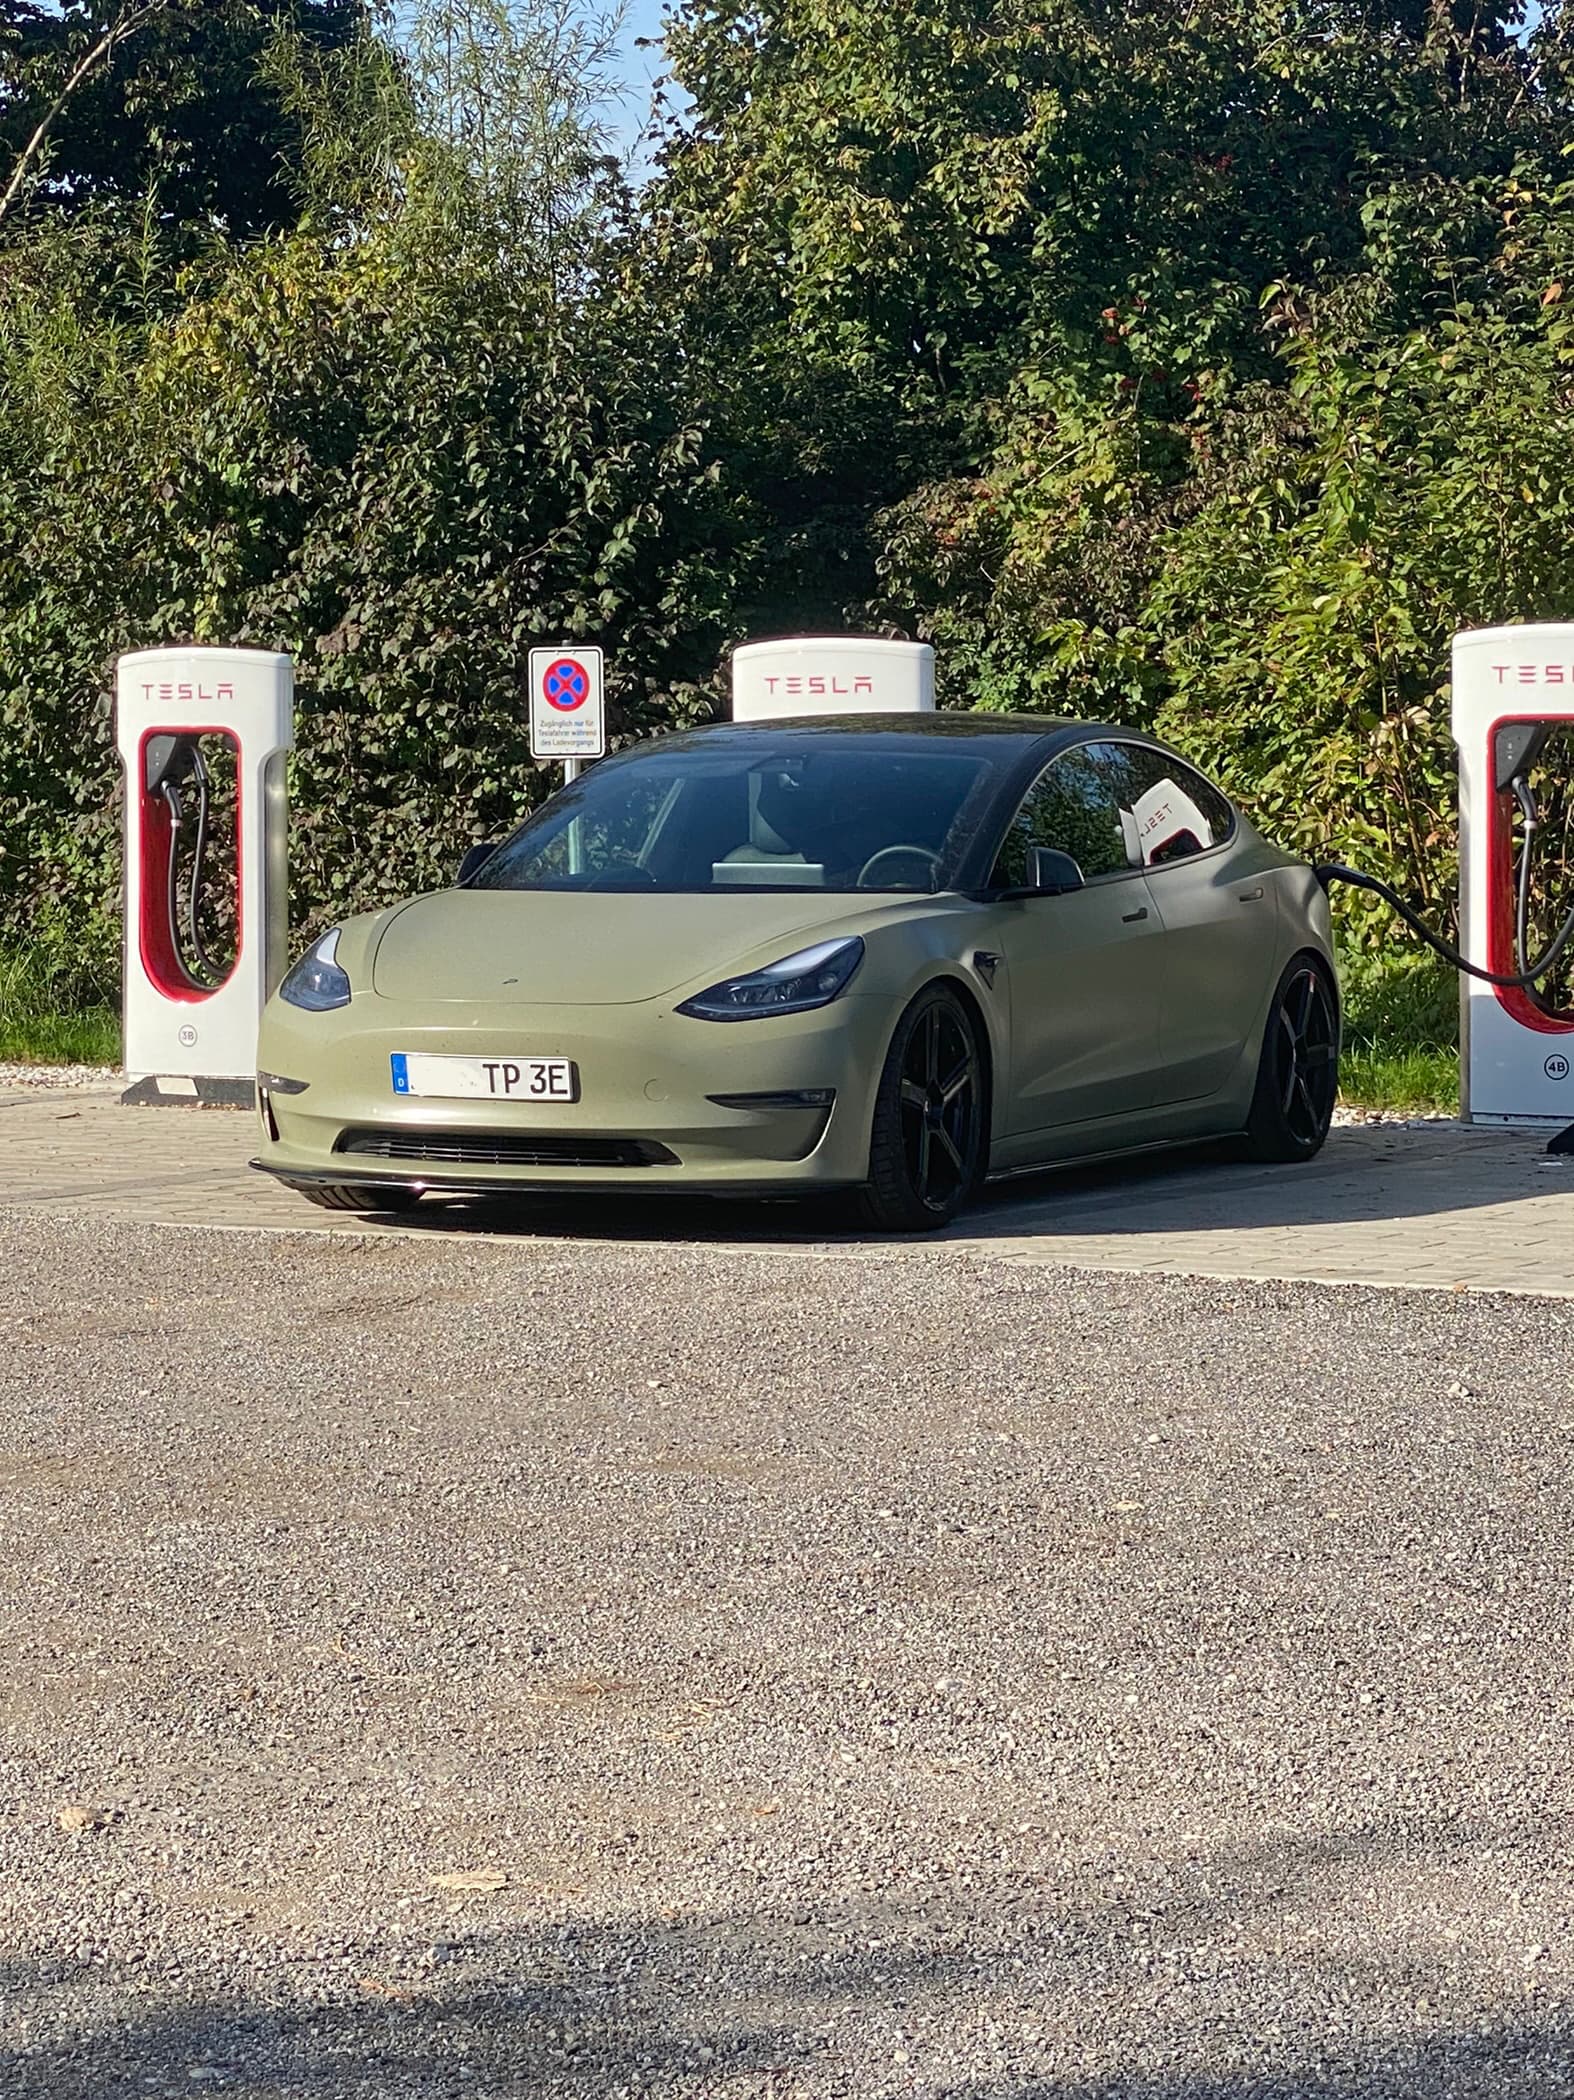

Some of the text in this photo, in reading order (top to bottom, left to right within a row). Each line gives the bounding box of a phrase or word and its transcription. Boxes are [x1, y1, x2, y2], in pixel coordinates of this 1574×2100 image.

[1491, 665, 1574, 684] TES
[141, 683, 233, 700] TESLA
[764, 676, 872, 694] TESLA
[182, 1031, 194, 1041] 3B
[1548, 1062, 1565, 1072] 4B
[397, 1077, 405, 1088] D
[482, 1063, 568, 1094] TP 3E
